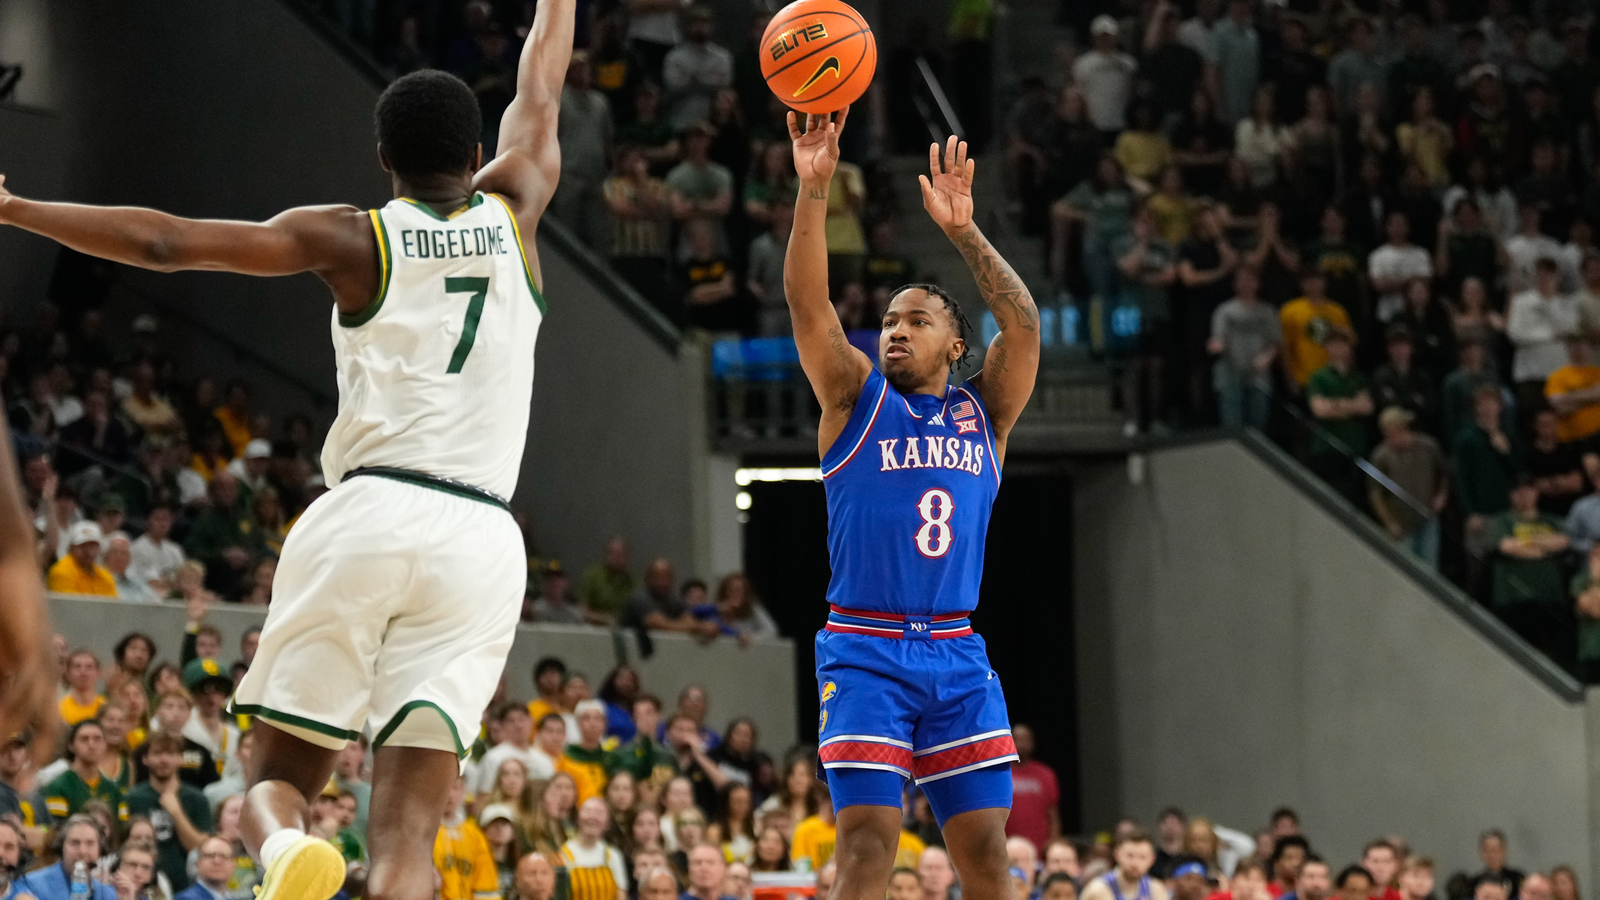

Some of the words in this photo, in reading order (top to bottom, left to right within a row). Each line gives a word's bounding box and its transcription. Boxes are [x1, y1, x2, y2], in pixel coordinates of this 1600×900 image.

[770, 22, 828, 61] ELITE
[809, 189, 827, 200] ALL
[401, 225, 508, 259] EDGECOME
[444, 276, 491, 375] 7
[878, 436, 984, 476] KANSAS
[913, 487, 956, 559] 8
[910, 622, 927, 632] KU
